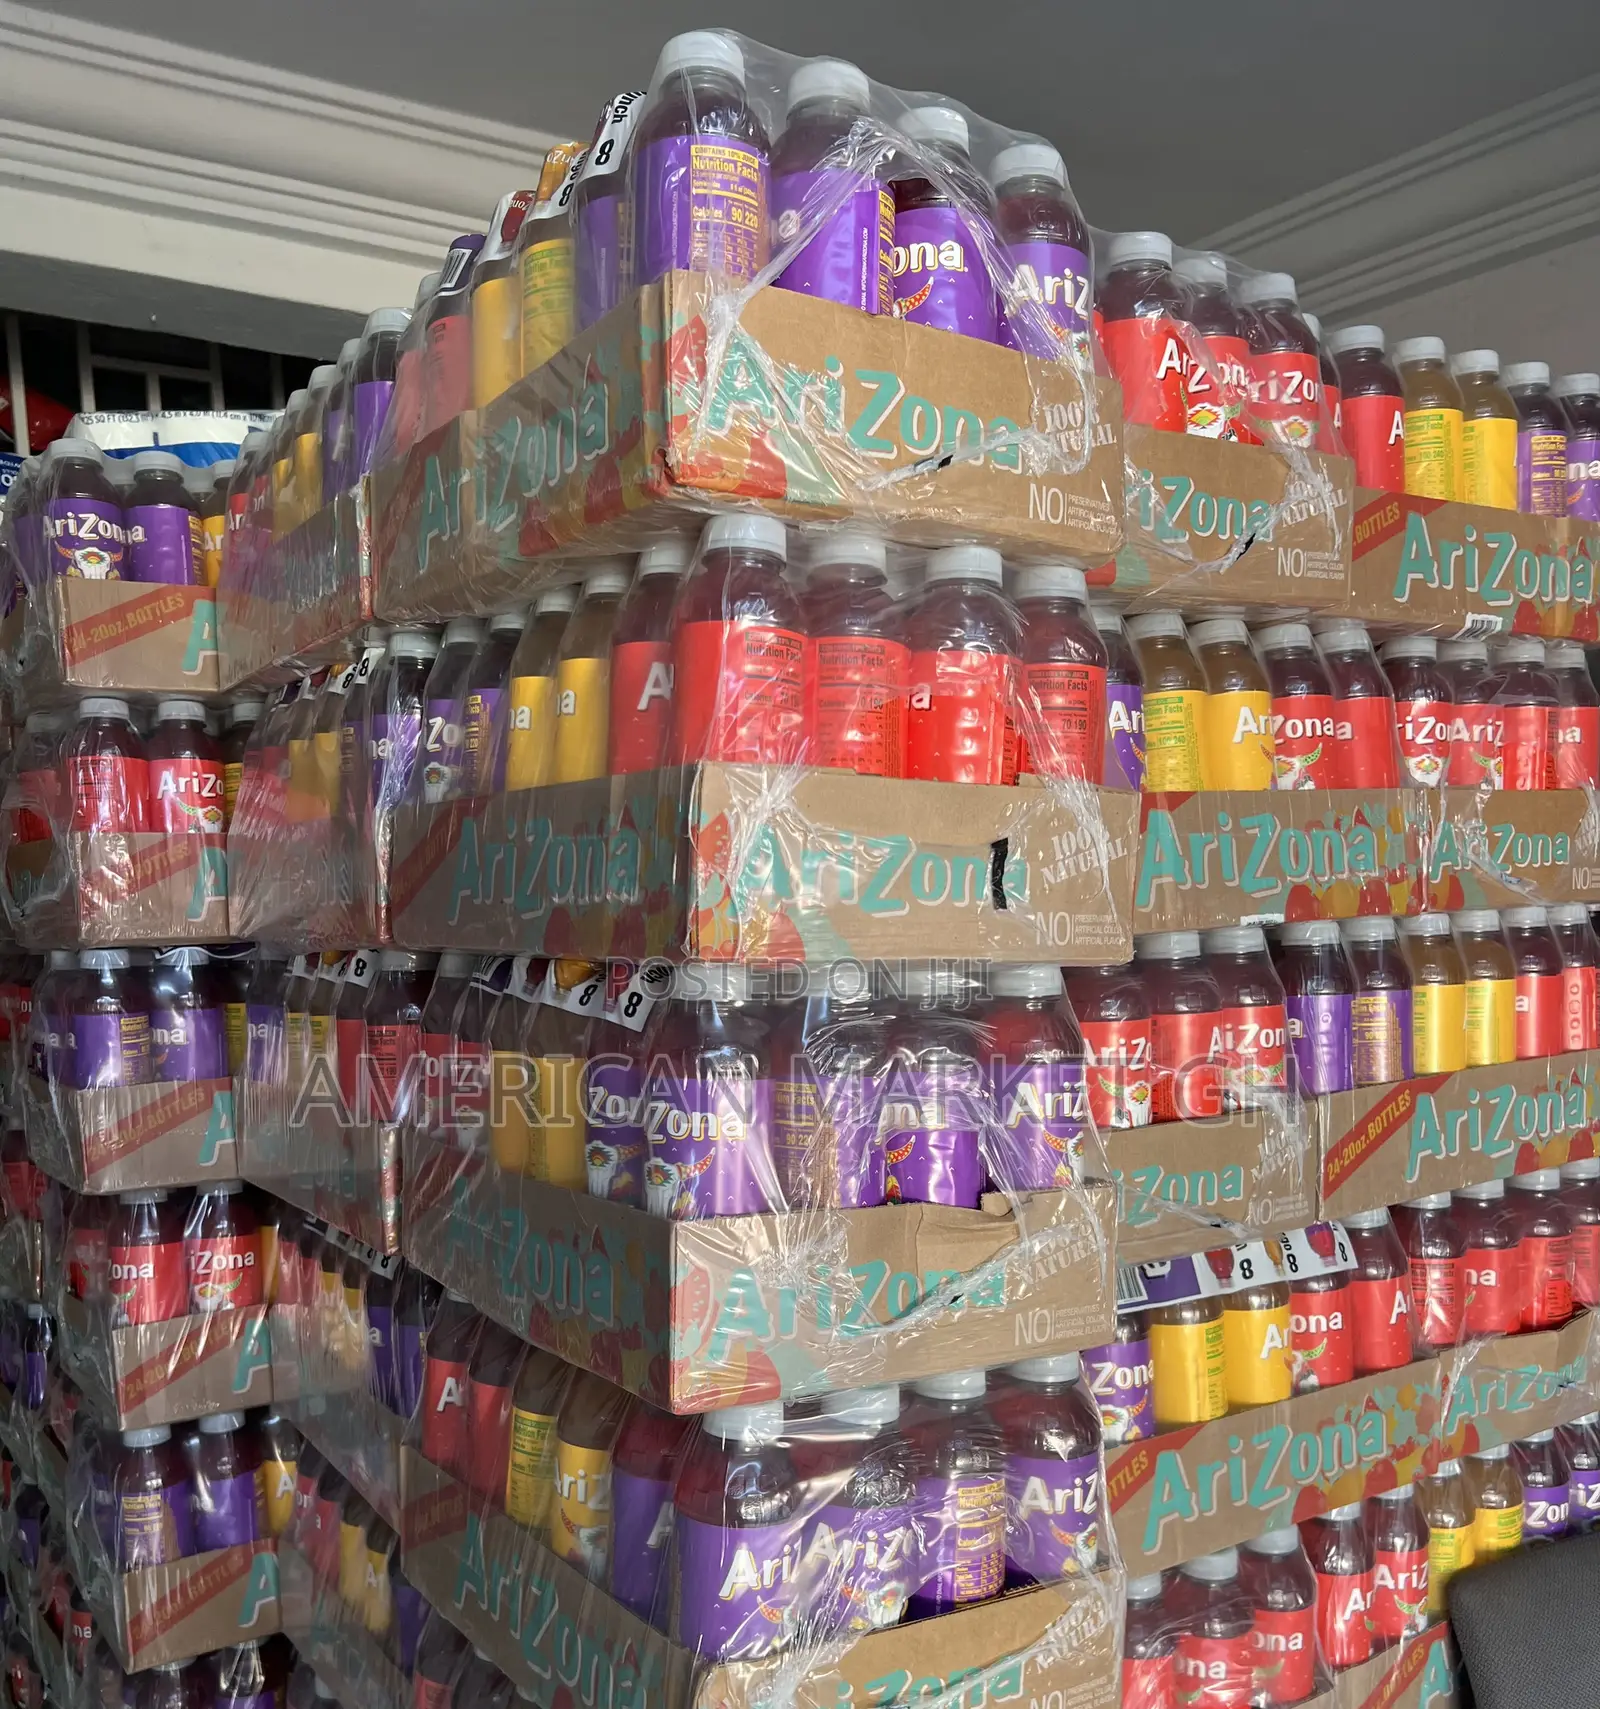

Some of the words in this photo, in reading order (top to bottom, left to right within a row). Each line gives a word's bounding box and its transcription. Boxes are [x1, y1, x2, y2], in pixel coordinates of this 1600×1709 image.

[595, 139, 614, 166] 8
[692, 155, 735, 174] Nutrition
[736, 160, 758, 182] Facts
[731, 207, 743, 223] 90
[744, 211, 759, 228] 220
[702, 333, 1023, 476] AriZona
[418, 380, 609, 575] AriZona
[1029, 483, 1064, 525] NO
[1277, 547, 1304, 578] NO
[1393, 511, 1594, 607] AriZona
[358, 658, 370, 677] 8
[819, 653, 859, 666] Nutrition
[861, 653, 884, 667] Facts
[342, 673, 354, 690] 8
[1067, 680, 1088, 691] Facts
[1061, 718, 1072, 729] 70
[1074, 718, 1087, 731] 190
[1051, 826, 1109, 861] 100
[1430, 821, 1570, 884] AriZona
[448, 816, 642, 926] AriZona
[728, 823, 1030, 918] AriZona
[1136, 806, 1378, 912] AriZona
[1572, 866, 1590, 890] NO
[1035, 911, 1070, 947] NO
[354, 957, 367, 977] 8
[579, 984, 598, 1007] 8
[623, 991, 643, 1018] 8
[1327, 1089, 1412, 1183] 24-20oz.BOTTLES
[1405, 1083, 1588, 1184] AriZona
[1248, 1198, 1273, 1227] NO
[1287, 1253, 1299, 1274] 8
[1338, 1242, 1349, 1263] 8
[1239, 1258, 1254, 1280] 8
[1014, 1308, 1051, 1346] NO
[1142, 1409, 1388, 1556] AriZona
